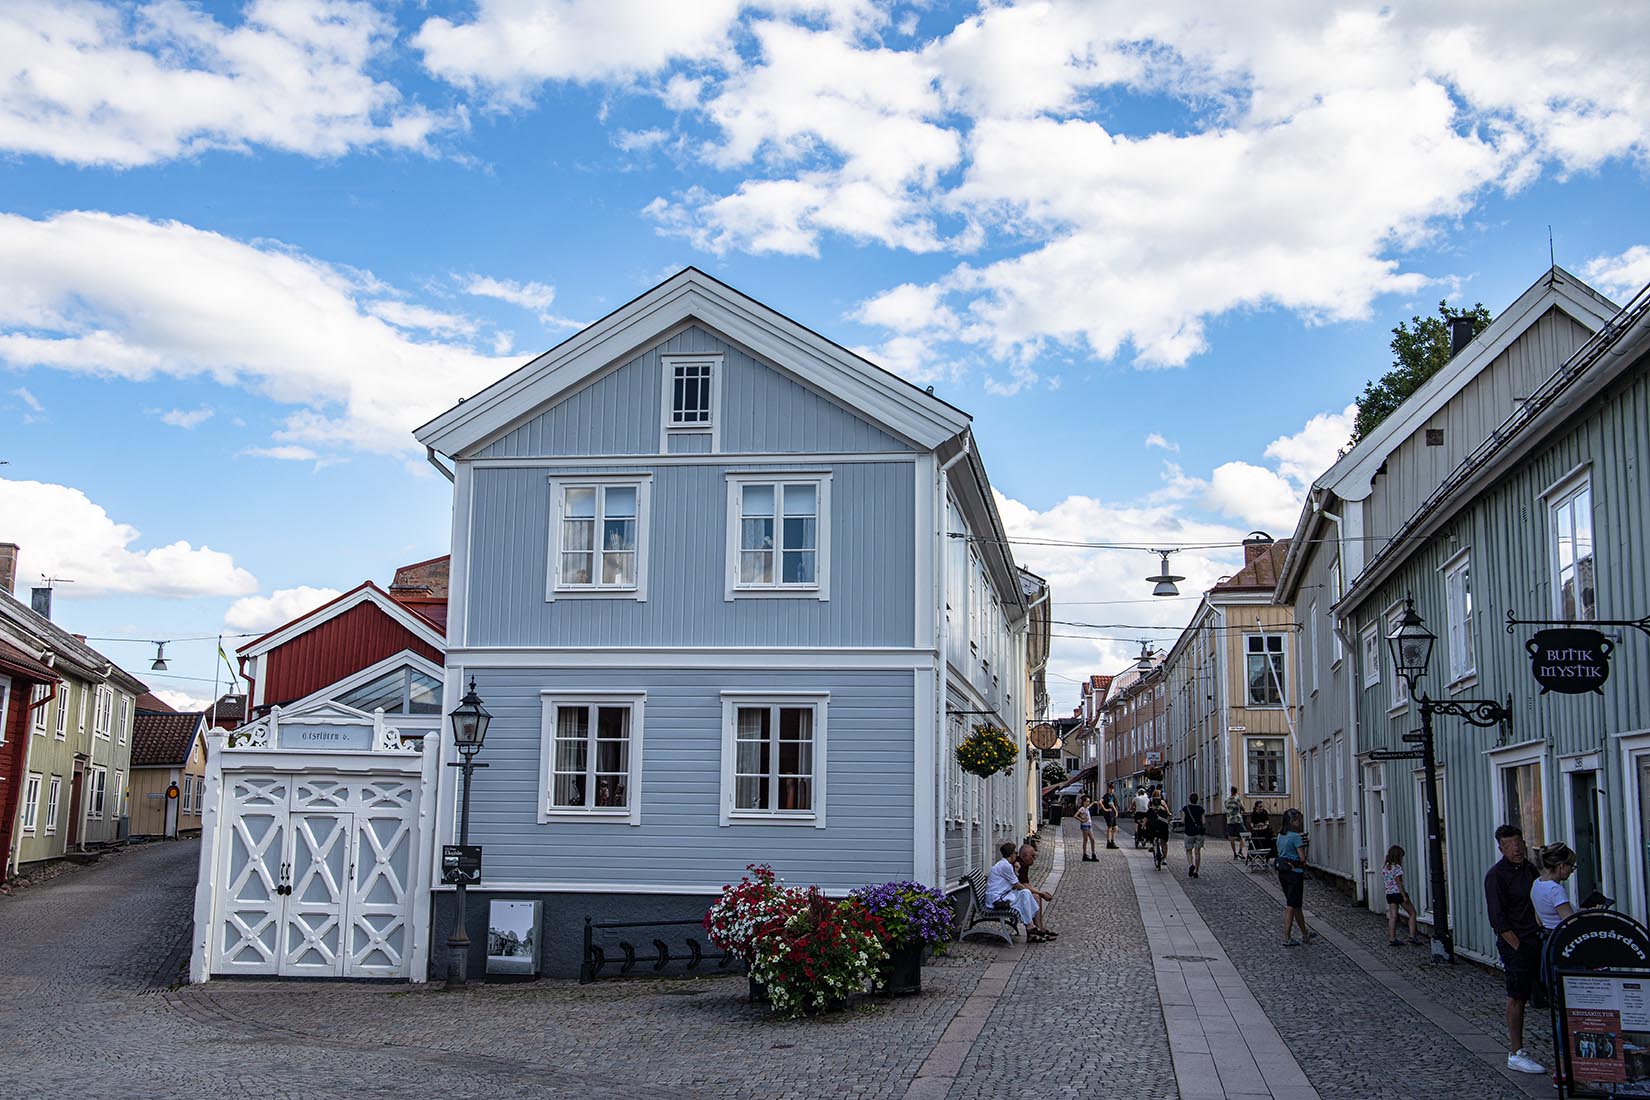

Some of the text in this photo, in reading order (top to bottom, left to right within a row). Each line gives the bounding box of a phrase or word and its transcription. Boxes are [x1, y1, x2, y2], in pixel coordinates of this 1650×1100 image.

[1546, 648, 1593, 661] BUTIK
[1540, 665, 1602, 678] MYSTIK
[1562, 930, 1646, 960] Krusagården
